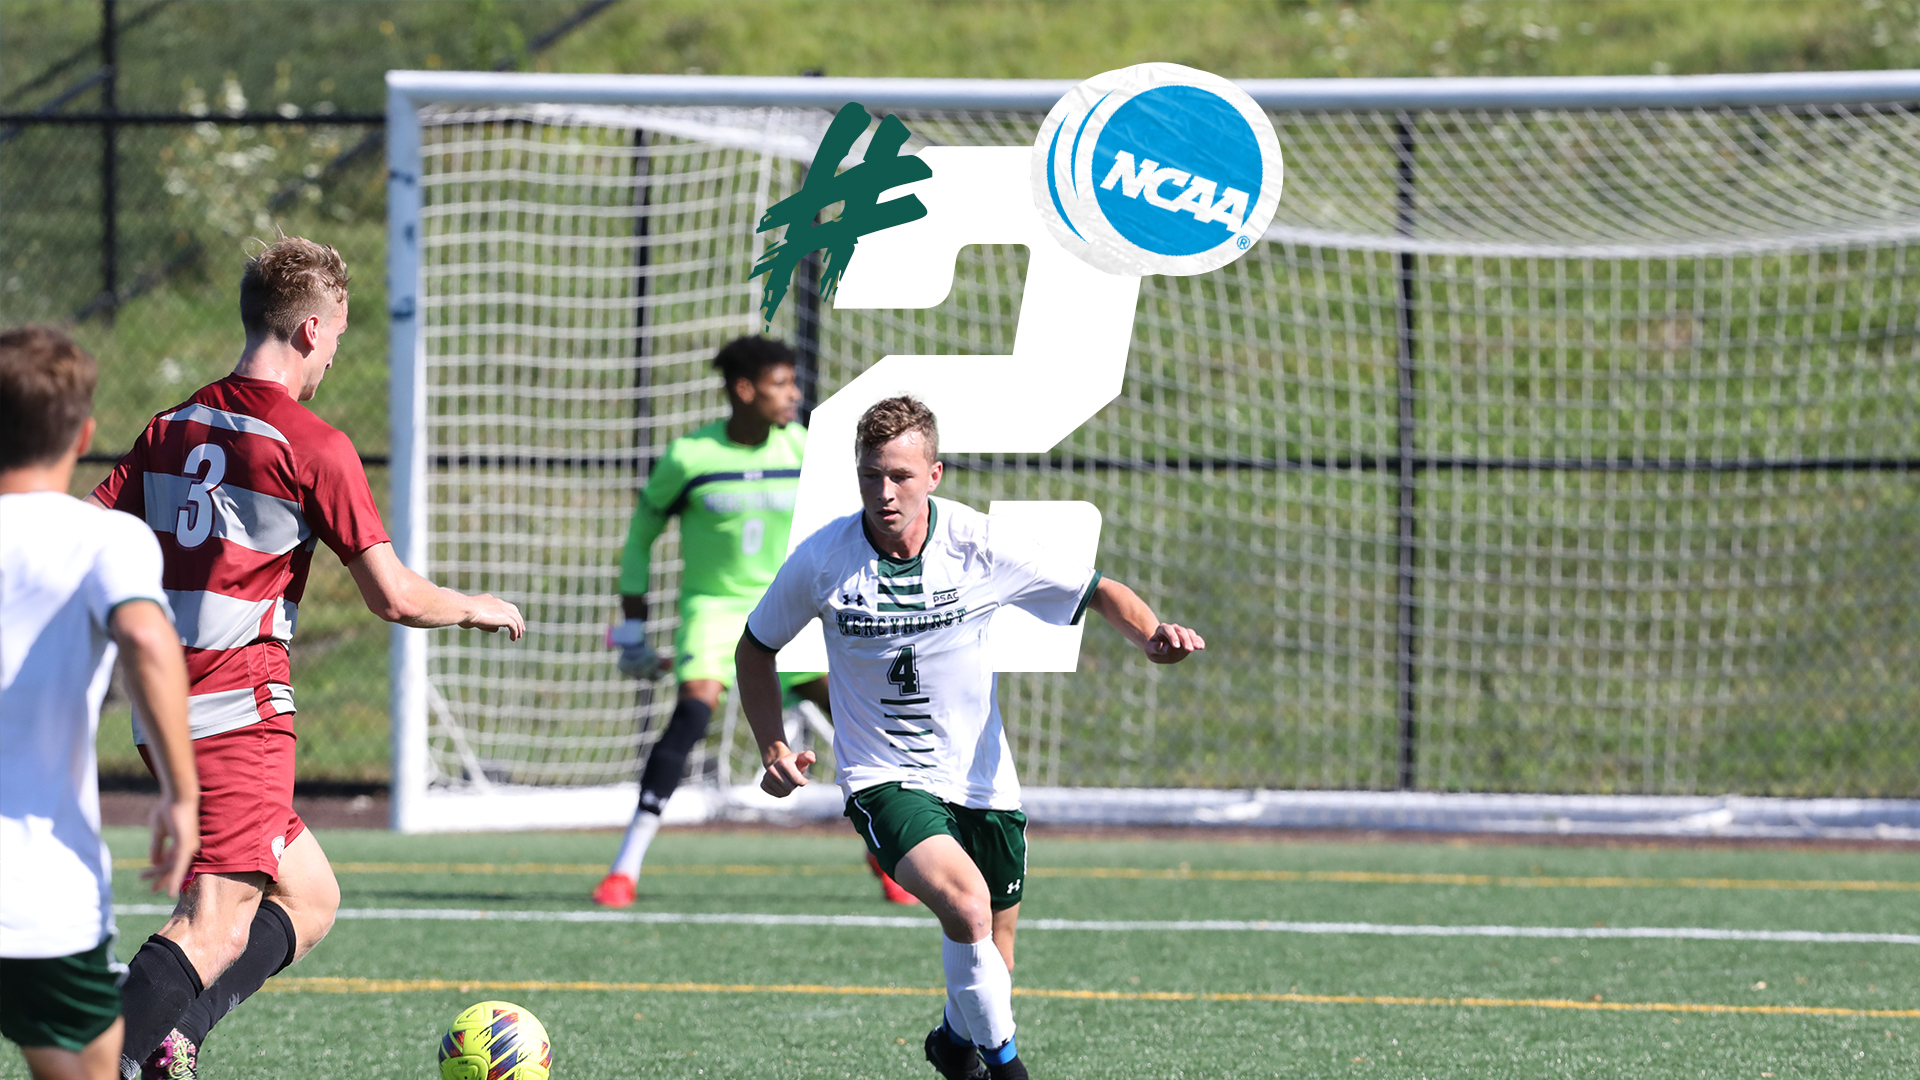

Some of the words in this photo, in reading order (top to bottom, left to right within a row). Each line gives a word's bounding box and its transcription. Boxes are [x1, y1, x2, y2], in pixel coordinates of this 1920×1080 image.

[177, 442, 227, 549] 3
[932, 591, 960, 603] PSAC
[835, 606, 967, 637] MERCYHURST
[886, 643, 921, 696] 4
